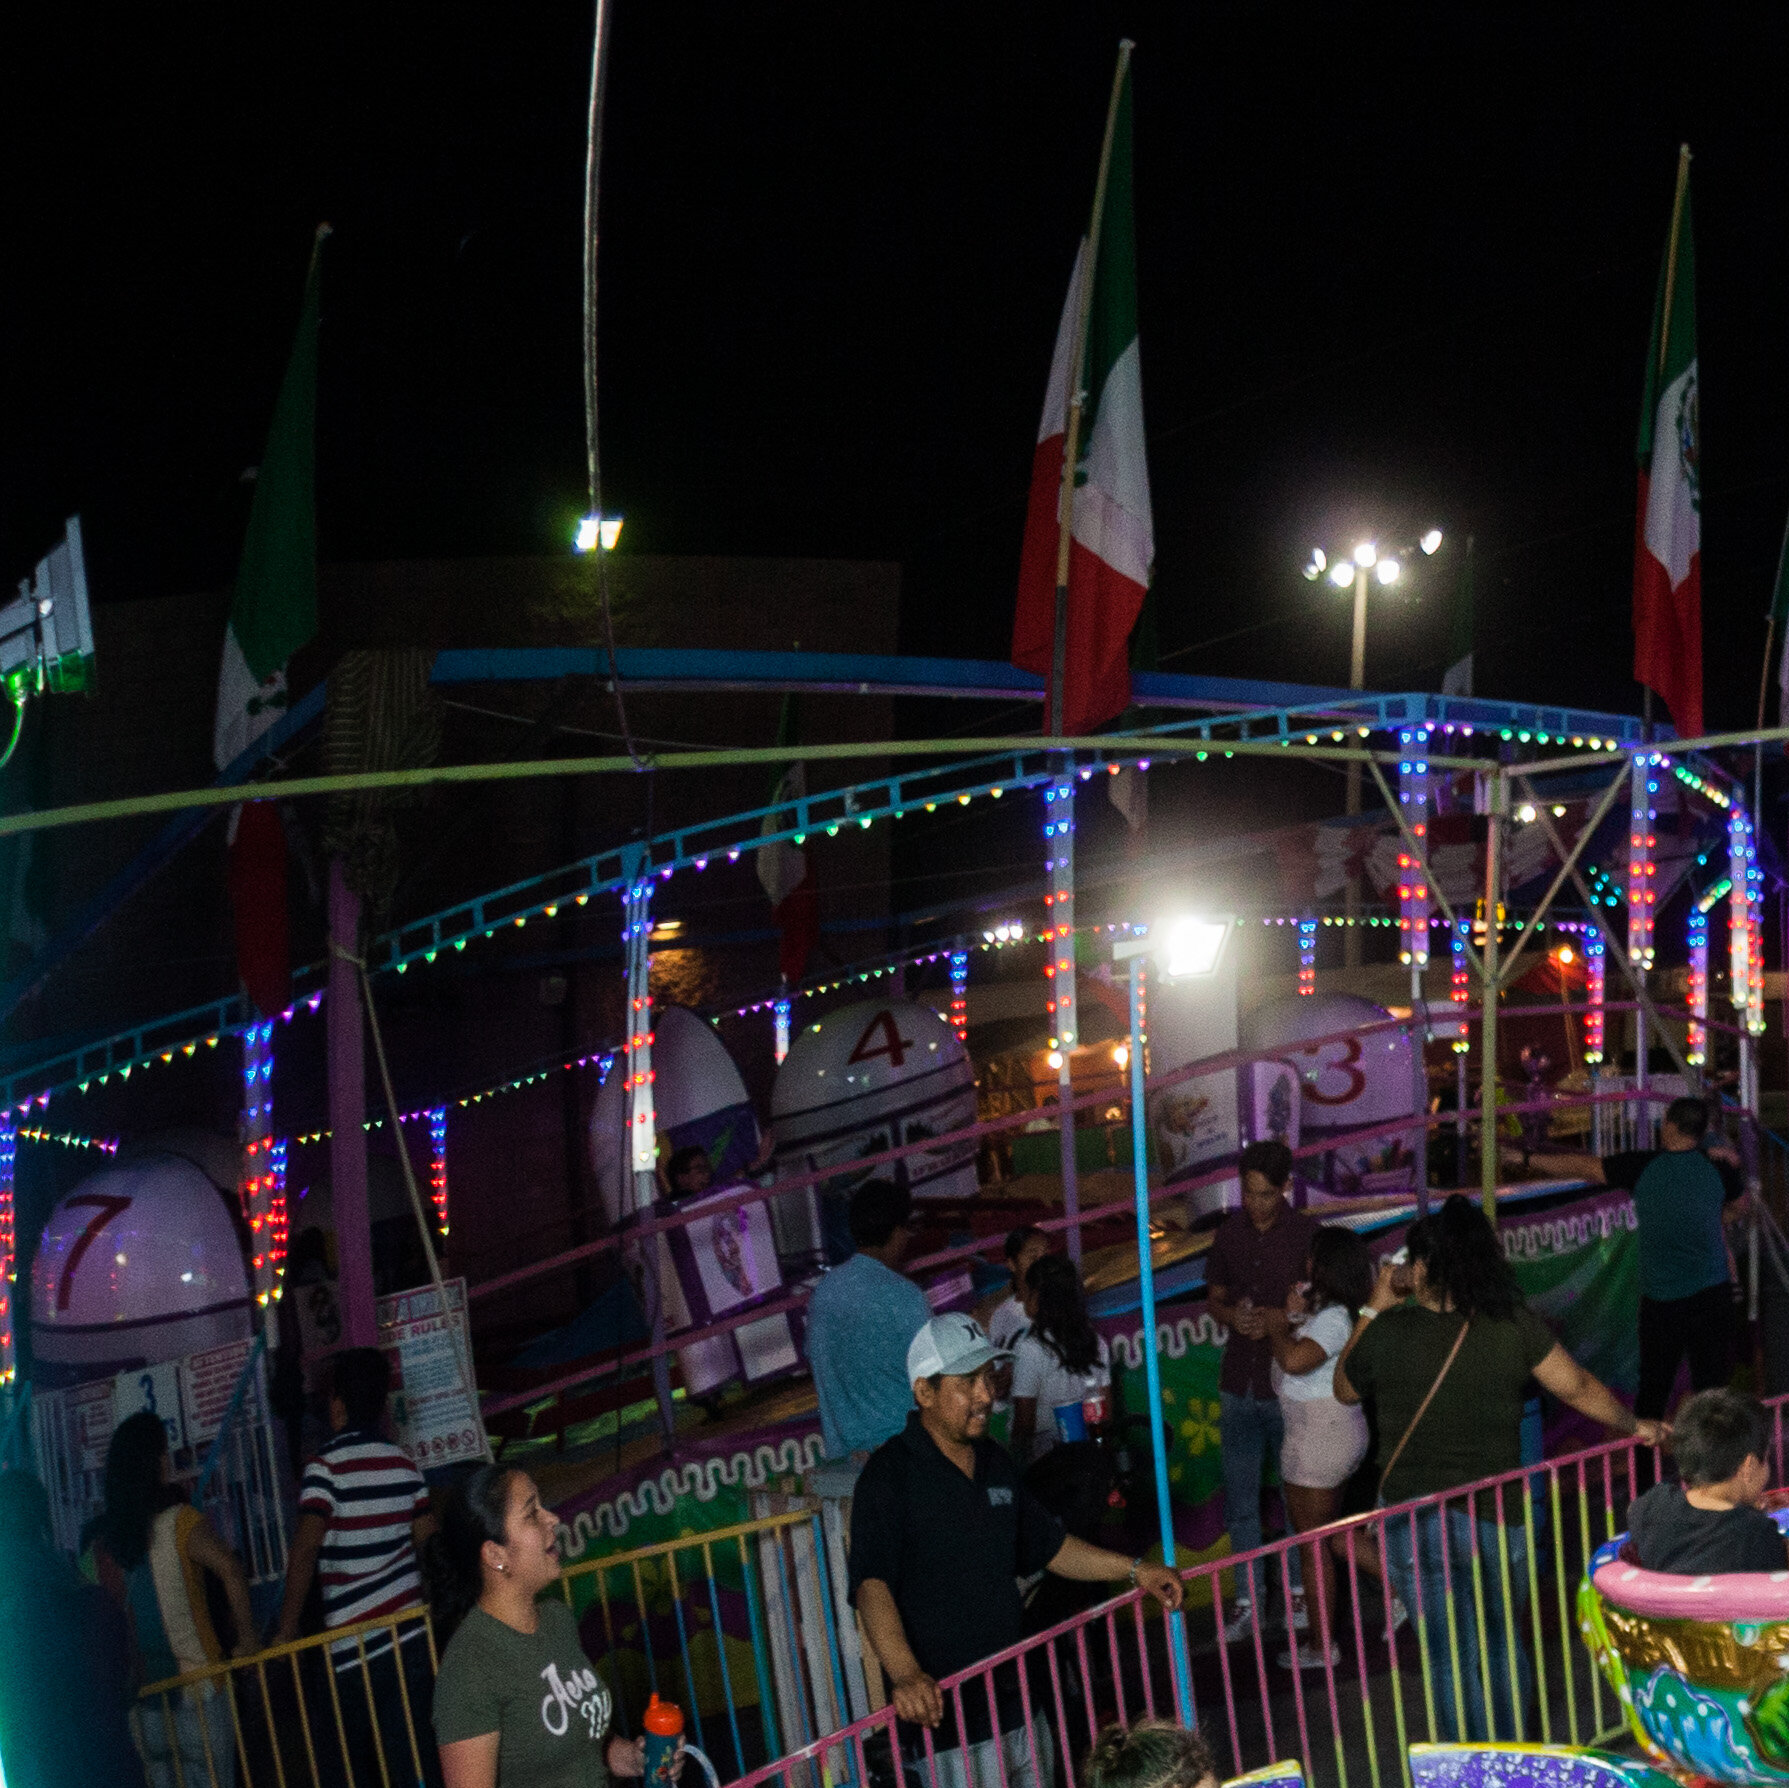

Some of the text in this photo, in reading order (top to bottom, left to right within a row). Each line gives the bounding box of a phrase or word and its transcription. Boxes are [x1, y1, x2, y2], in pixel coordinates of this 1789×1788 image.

[846, 1009, 913, 1069] 4
[1301, 1033, 1366, 1106] 3
[58, 1194, 132, 1312] 7
